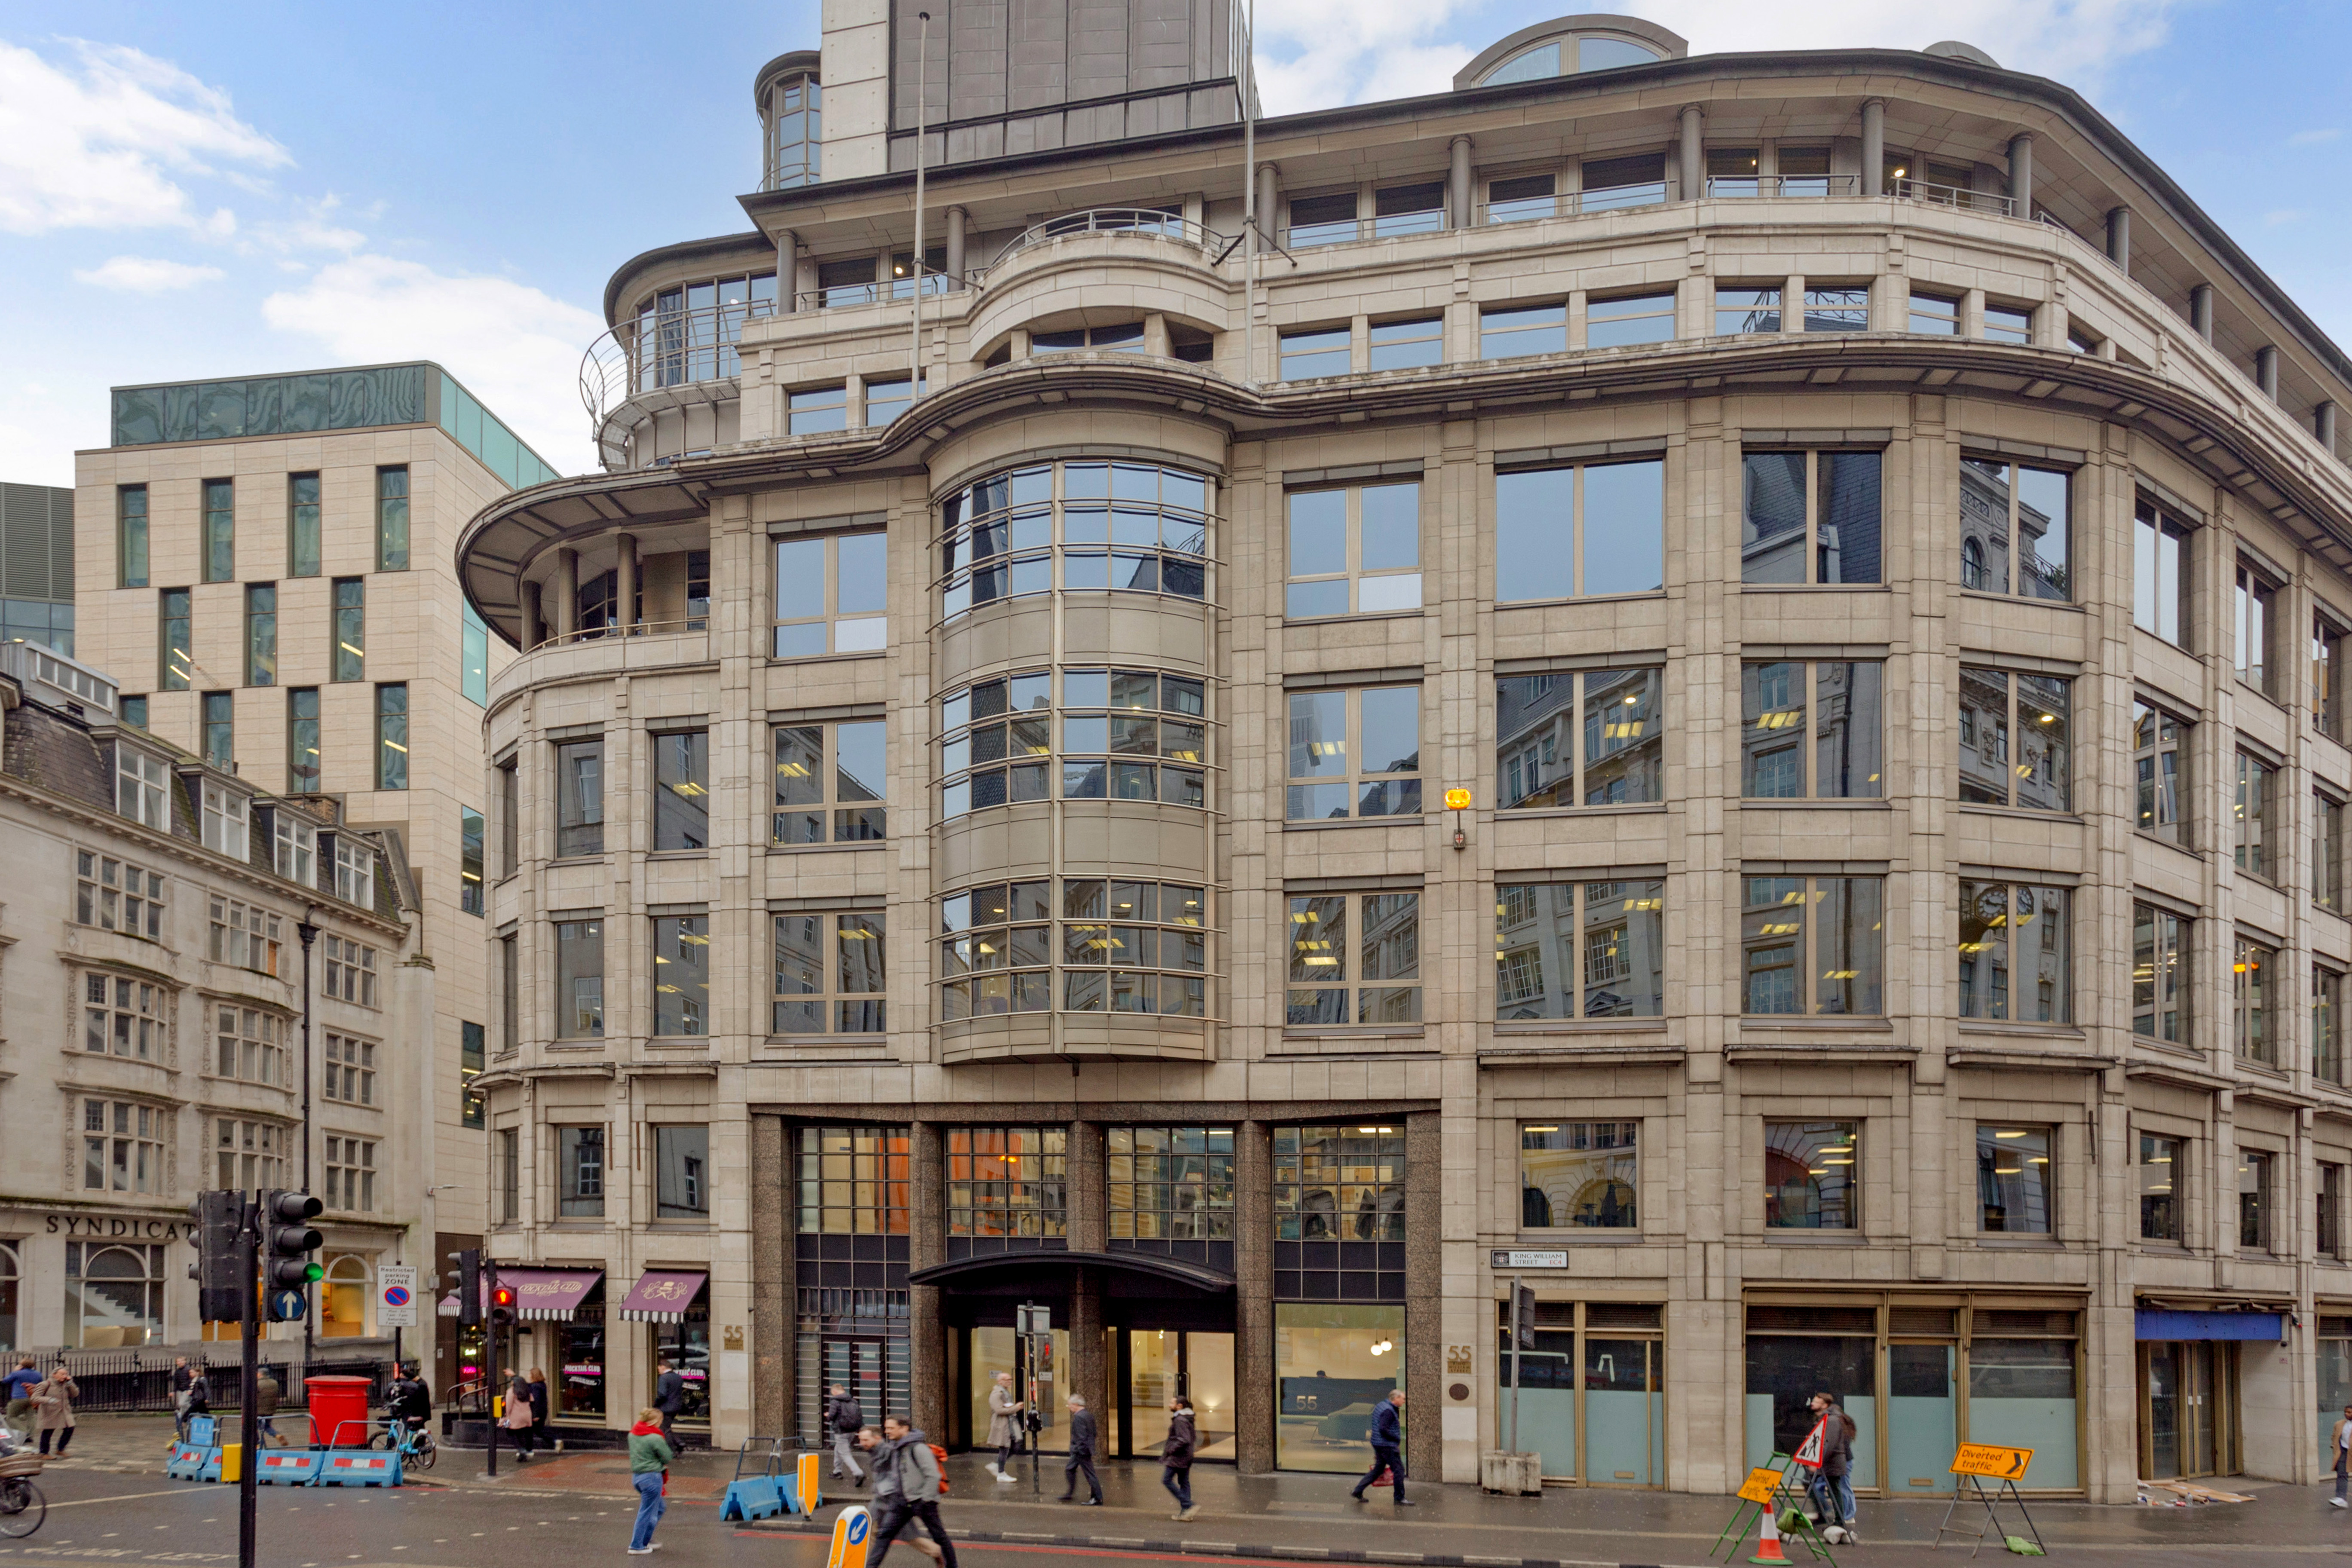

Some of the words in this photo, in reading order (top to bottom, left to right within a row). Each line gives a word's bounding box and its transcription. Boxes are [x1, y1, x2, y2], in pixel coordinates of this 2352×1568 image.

[519, 1283, 560, 1292] COCKTAIL
[560, 1283, 582, 1292] CLUB
[723, 1326, 743, 1340] 55
[1447, 1346, 1471, 1361] 55
[1296, 1396, 1317, 1410] 55
[1962, 1449, 2003, 1461] Diverted
[1962, 1460, 1992, 1470] traffic
[1749, 1472, 1770, 1484] Diverted
